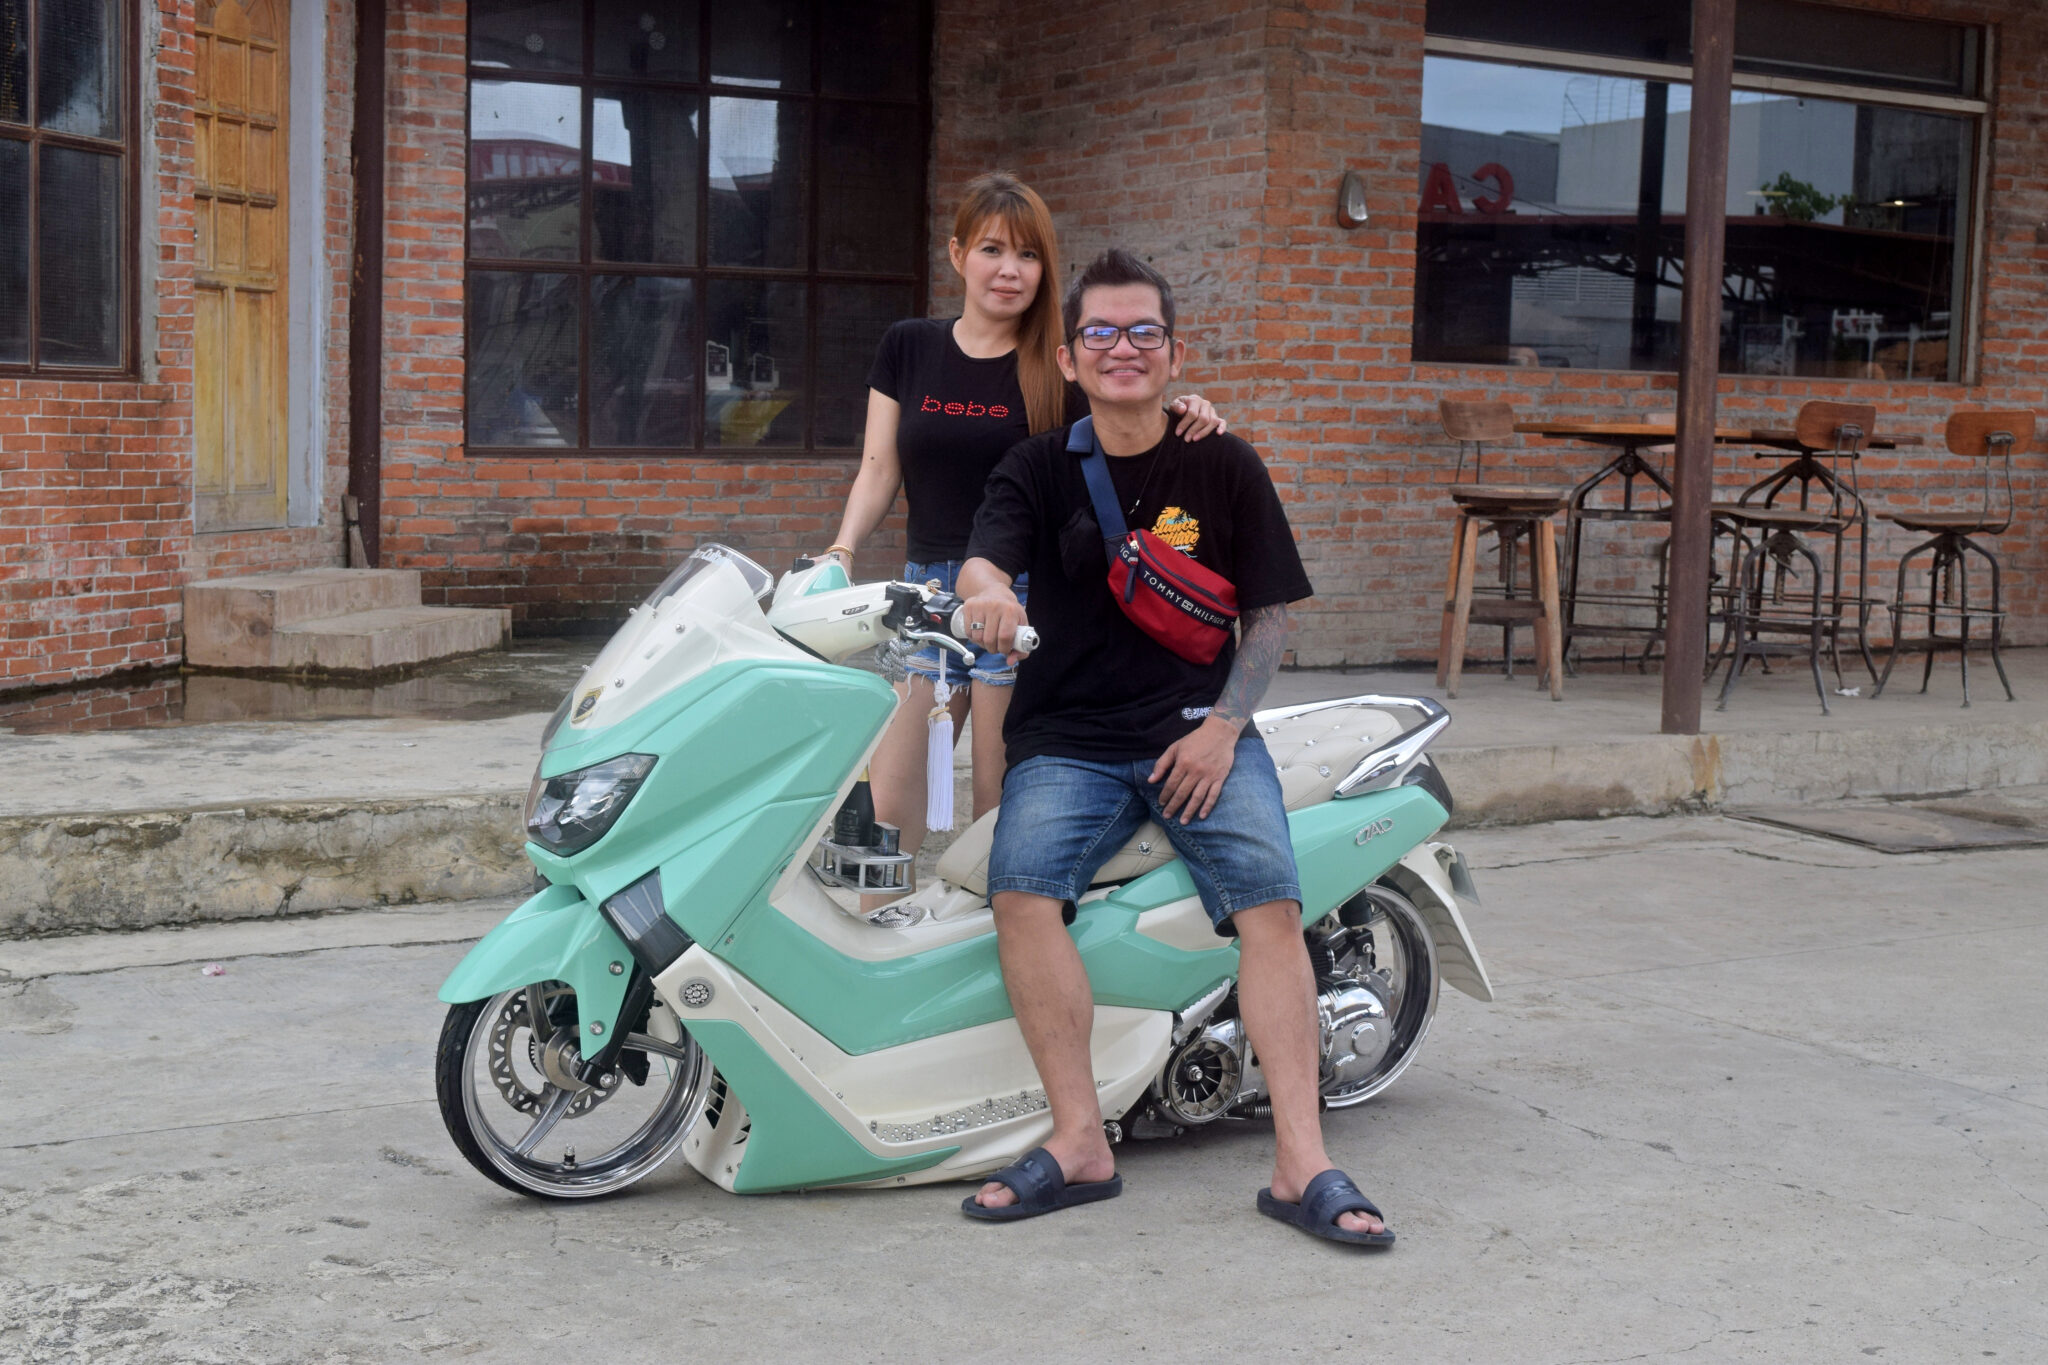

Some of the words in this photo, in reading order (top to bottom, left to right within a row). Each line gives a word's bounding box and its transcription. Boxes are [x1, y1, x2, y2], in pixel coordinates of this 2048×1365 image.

[920, 395, 1009, 418] bebe
[1143, 570, 1182, 603] TOMMY
[1193, 607, 1226, 625] HILFIGER
